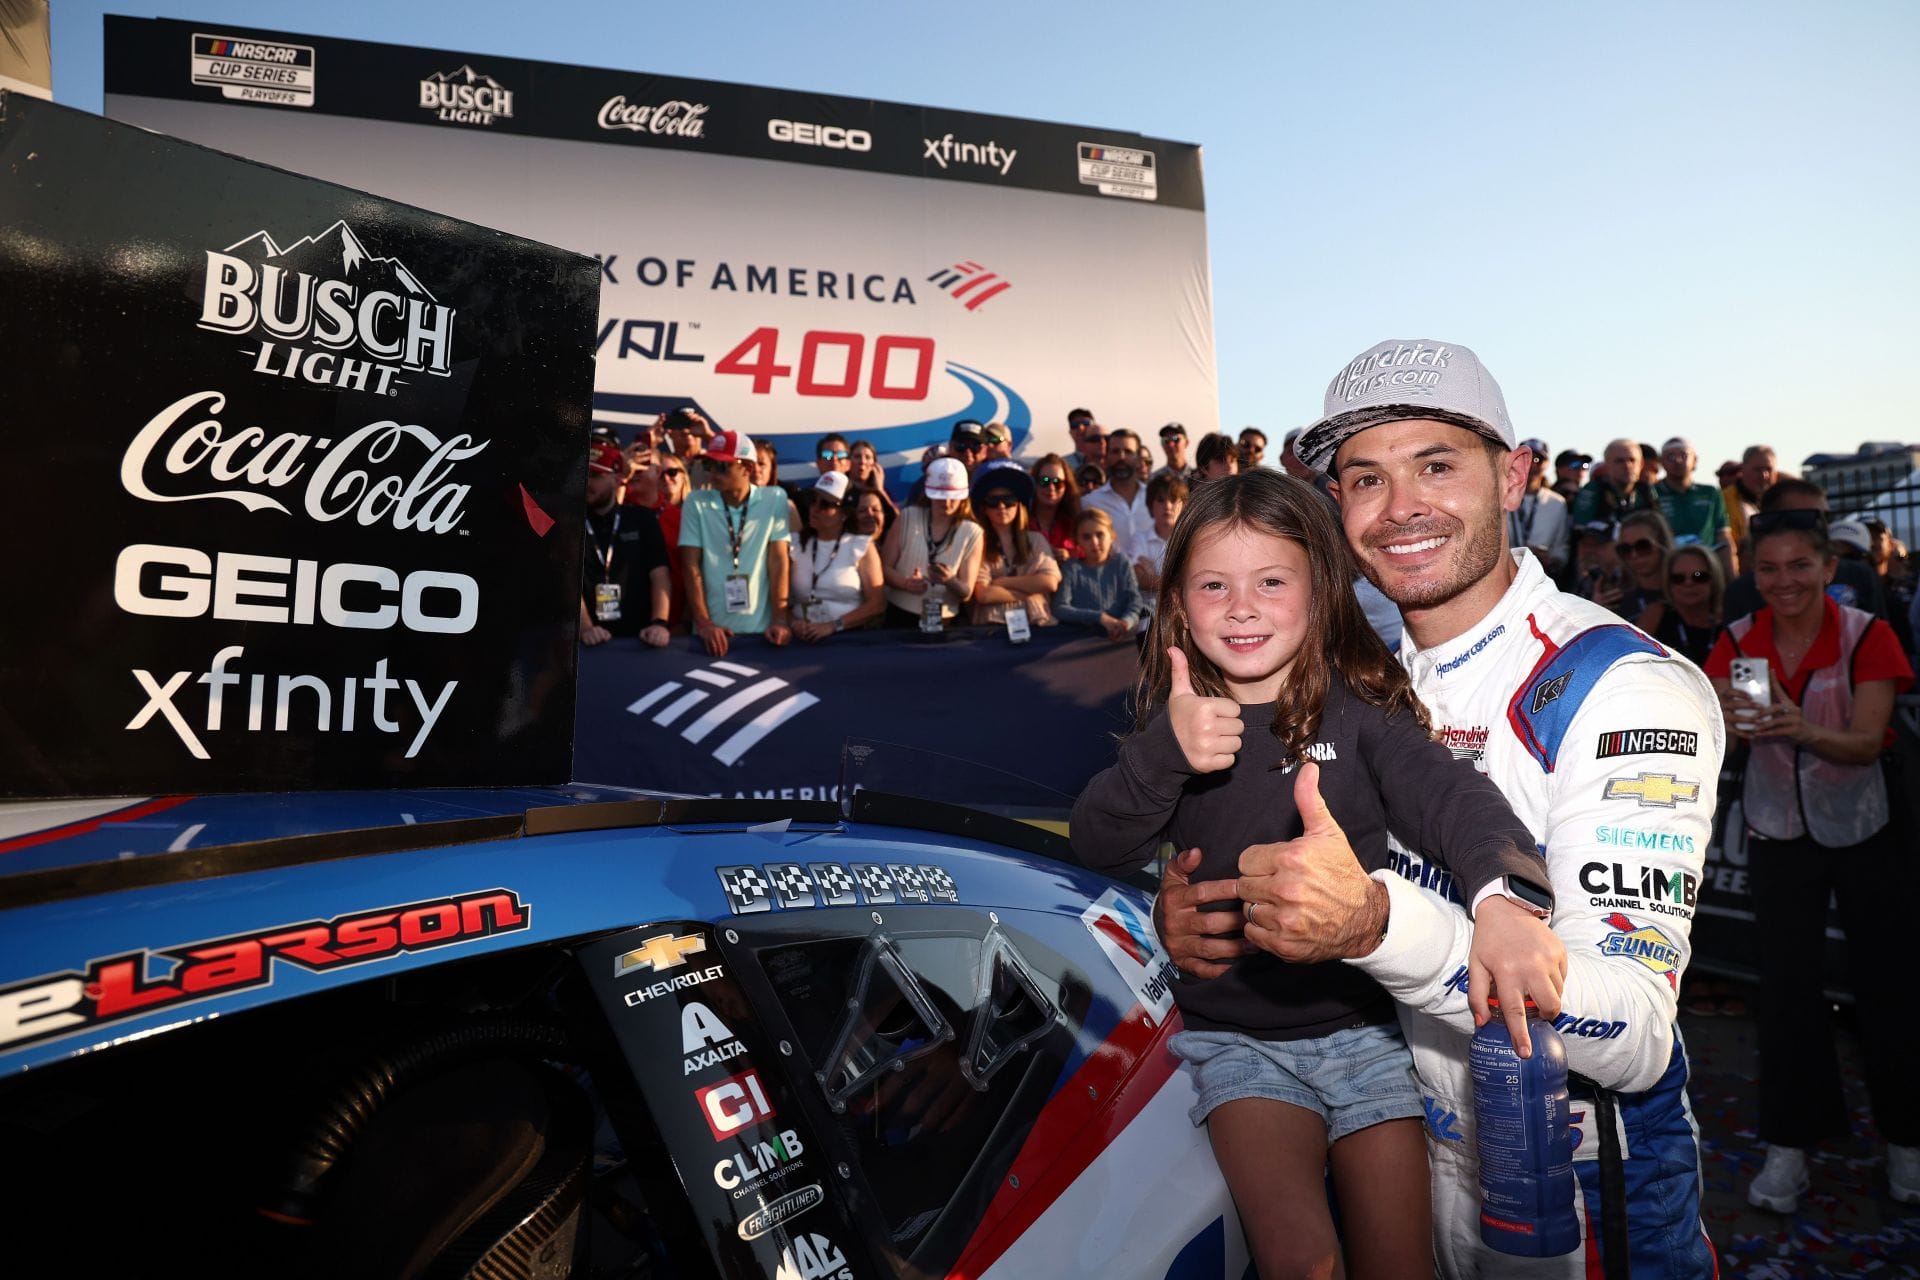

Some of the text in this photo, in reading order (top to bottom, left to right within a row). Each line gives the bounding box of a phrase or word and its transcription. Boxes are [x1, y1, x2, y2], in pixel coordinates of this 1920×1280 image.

[209, 61, 297, 83] CUP SERIES
[231, 43, 297, 63] NASCAR
[240, 88, 296, 103] PLAYOFFS
[420, 80, 513, 118] BUSCH
[438, 110, 494, 125] LIGHT
[597, 95, 710, 138] Coca-Cola
[767, 118, 872, 152] GEICO
[924, 134, 1017, 175] xfinity
[637, 257, 696, 288] OF
[711, 262, 917, 305] AMERICA
[196, 250, 457, 378] BUSCH
[253, 341, 401, 397] LIGHT
[714, 326, 936, 402] 400
[1333, 343, 1452, 397] Hendrick
[120, 391, 491, 536] Coca-Cola
[114, 544, 479, 633] GEICO
[124, 646, 458, 759] xfinity
[1626, 731, 1696, 753] NASCAR
[1595, 825, 1695, 854] SIEMENS
[915, 889, 959, 902] 16 12
[1578, 861, 1697, 908] CLIMB
[1590, 897, 1645, 910] CHANNEL
[624, 965, 724, 1007] CHEVROLET
[684, 1040, 748, 1076] AXALTA
[1505, 1075, 1519, 1084] 25
[705, 1074, 771, 1132] CI
[713, 1129, 804, 1190] CLIMB
[733, 1160, 804, 1199] CHANNEL SOLUTIONS
[748, 1189, 818, 1235] FREIGHTLINER
